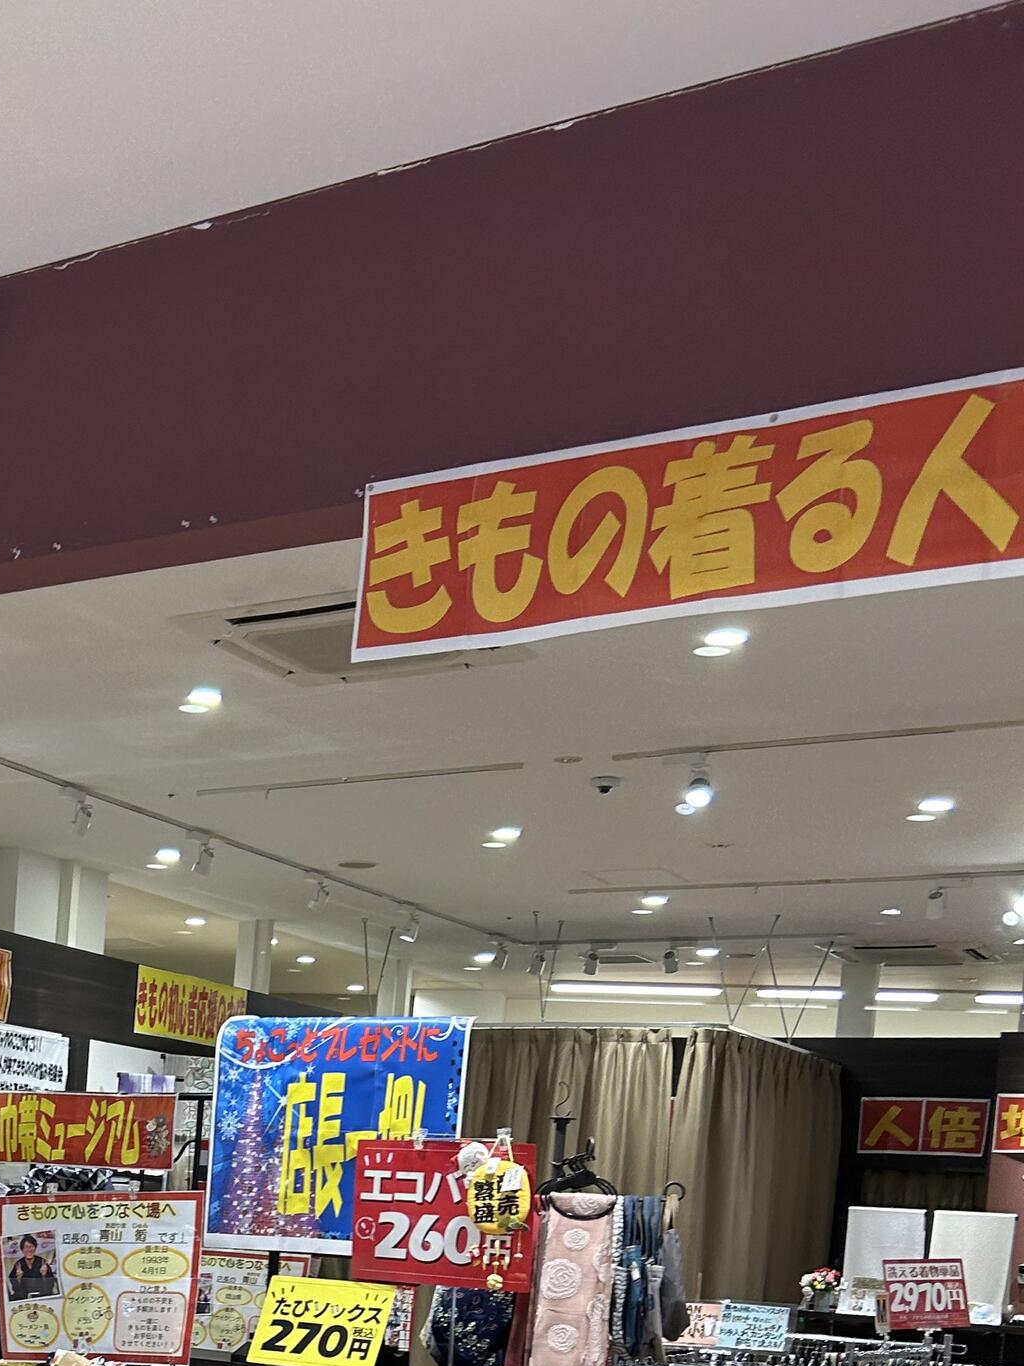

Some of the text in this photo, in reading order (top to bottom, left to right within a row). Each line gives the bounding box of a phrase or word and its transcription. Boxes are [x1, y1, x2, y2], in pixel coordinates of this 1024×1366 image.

[366, 393, 1020, 635] きもの着る人
[235, 1026, 442, 1063] ちょこっとプレゼントに
[17, 1202, 177, 1221] きもので心をつなぐ場へ
[260, 1319, 373, 1361] 270円
